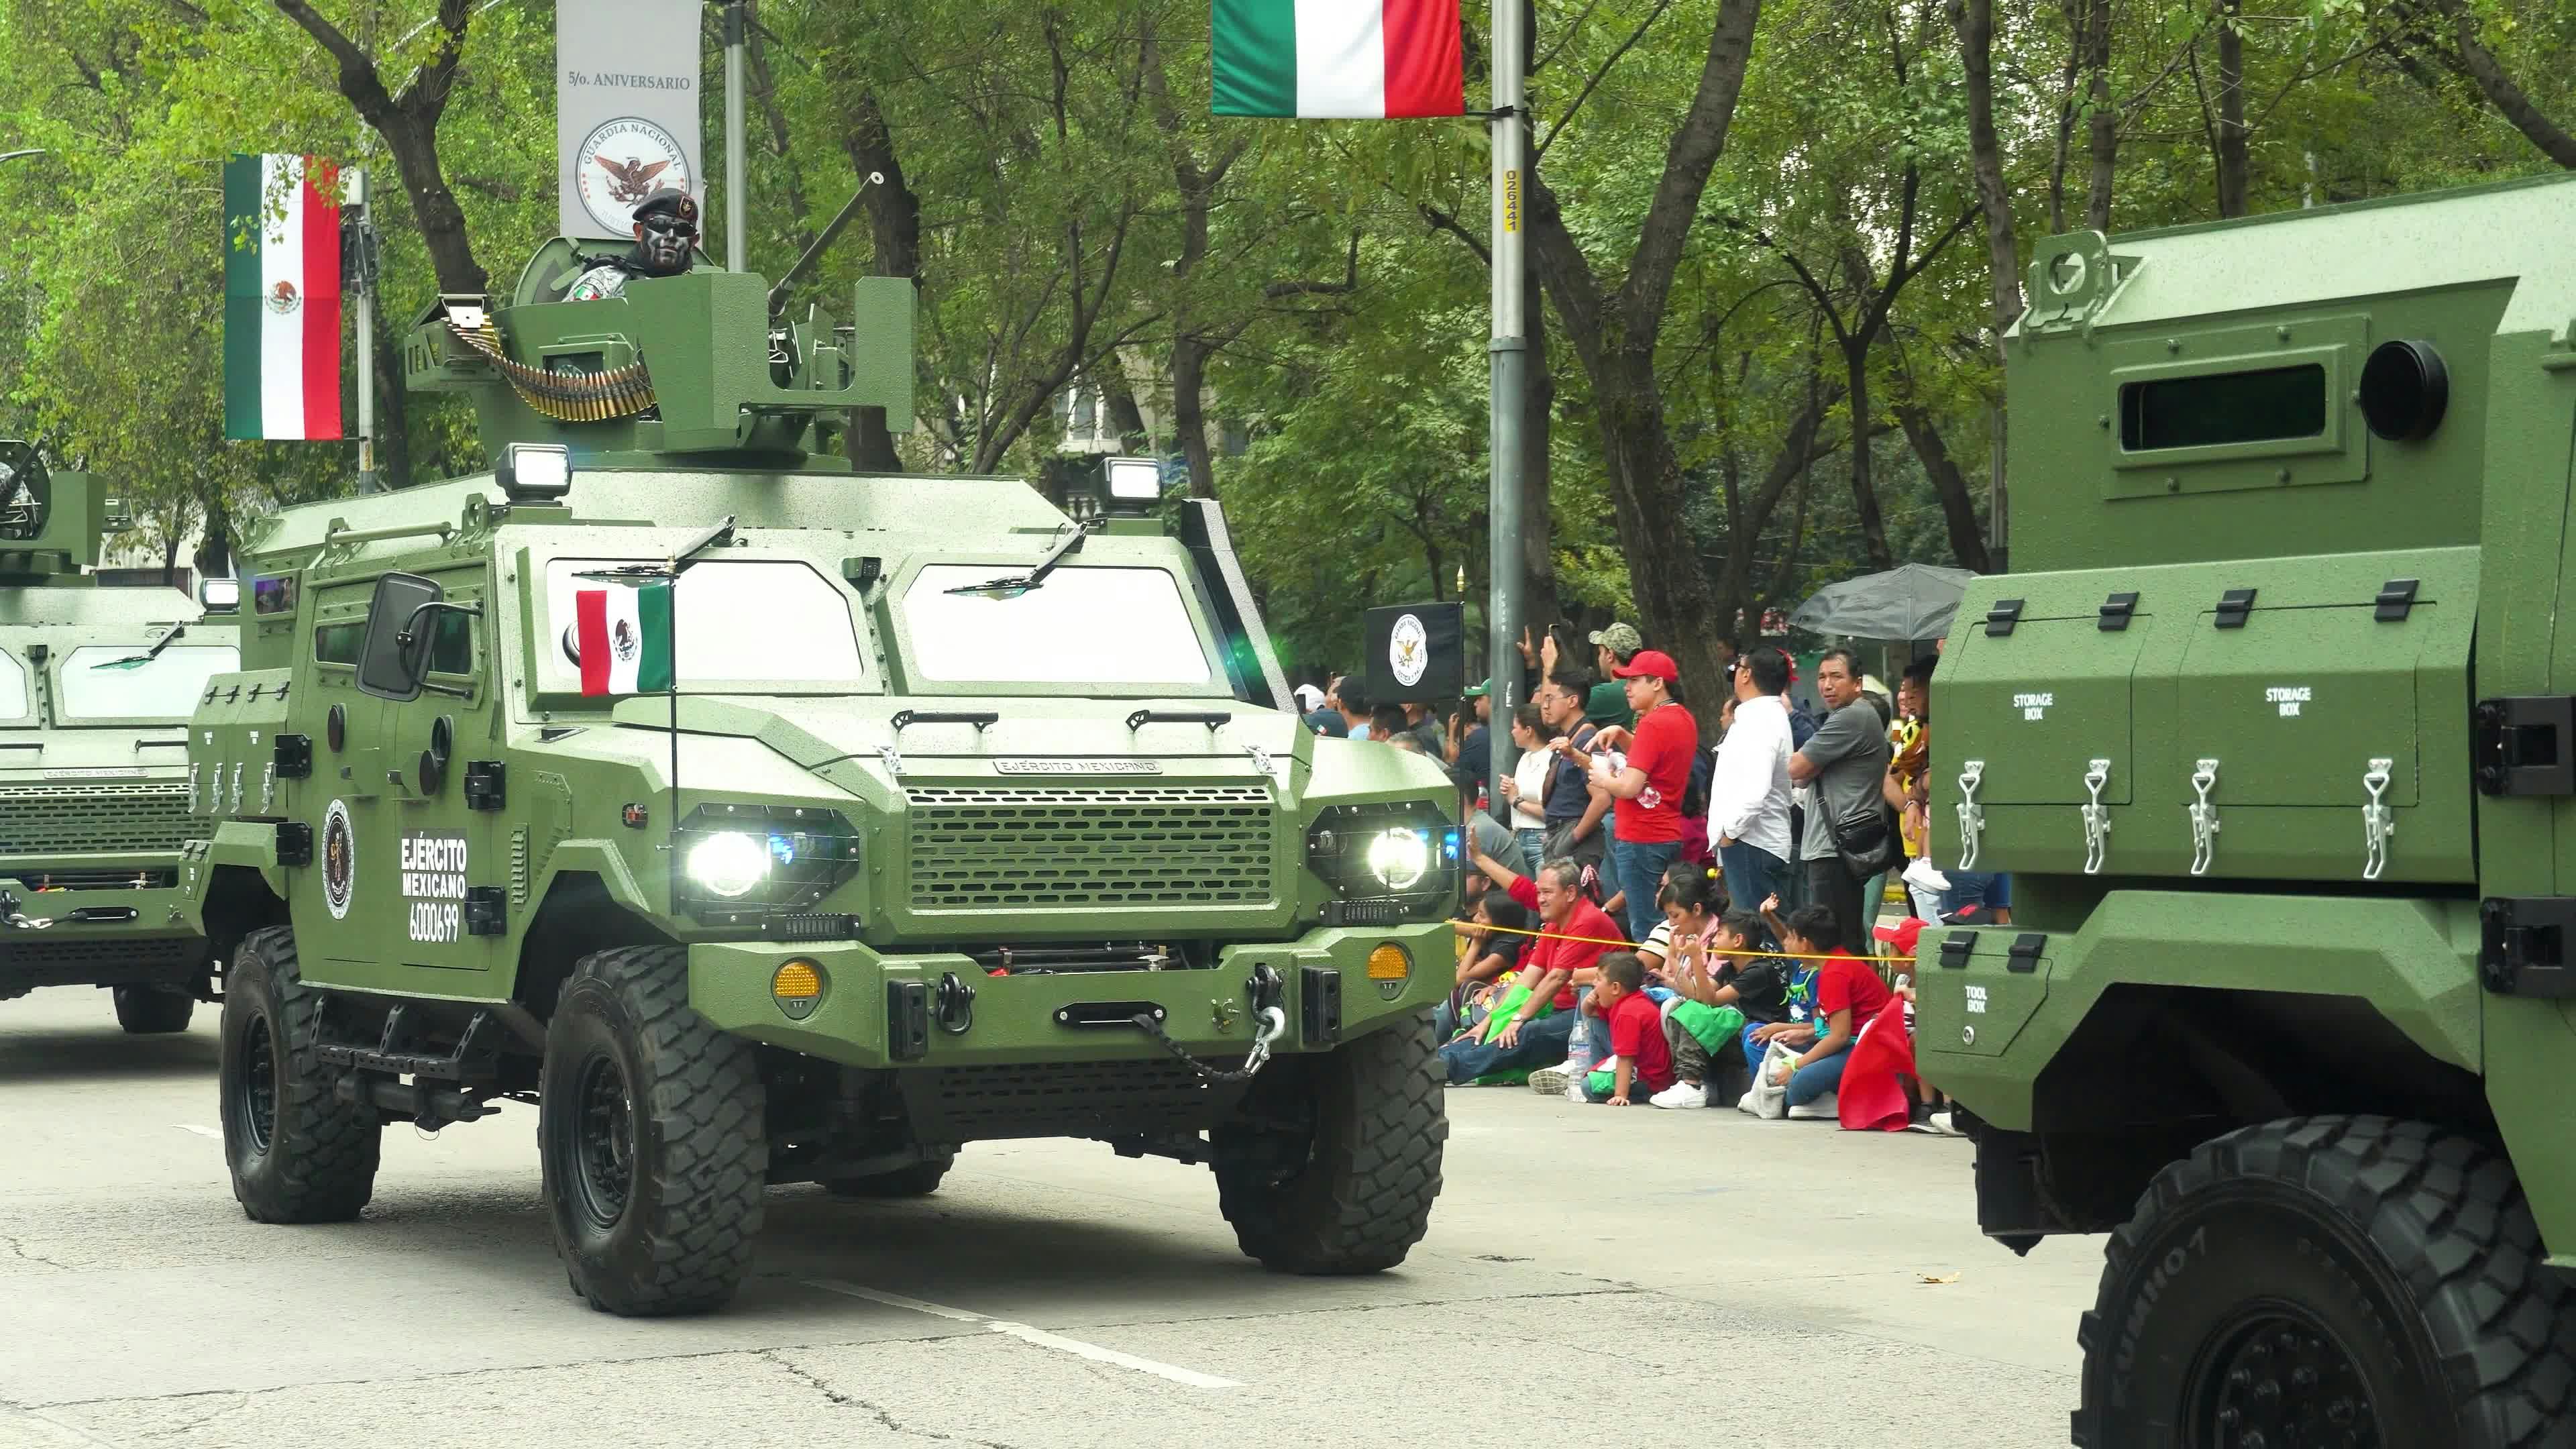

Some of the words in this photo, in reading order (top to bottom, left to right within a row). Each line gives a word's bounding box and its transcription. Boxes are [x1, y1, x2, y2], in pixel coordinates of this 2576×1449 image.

[594, 74, 690, 91] ANIVERSARIO
[584, 123, 627, 165] GUARDIA
[631, 123, 682, 170] NACIONAL
[1506, 170, 1517, 231] 026441
[2013, 693, 2053, 707] STORAGE
[2265, 687, 2311, 702] STORAGE
[2025, 707, 2043, 720] BOX
[2279, 702, 2300, 716] BOX
[1078, 762, 1157, 771] MEXICANO
[401, 831, 467, 872] EJÉRCITO
[402, 873, 466, 899] MEXICANO
[410, 902, 459, 943] 6000699
[1965, 985, 1987, 1000] TOOL
[1967, 999, 1986, 1013] BOX
